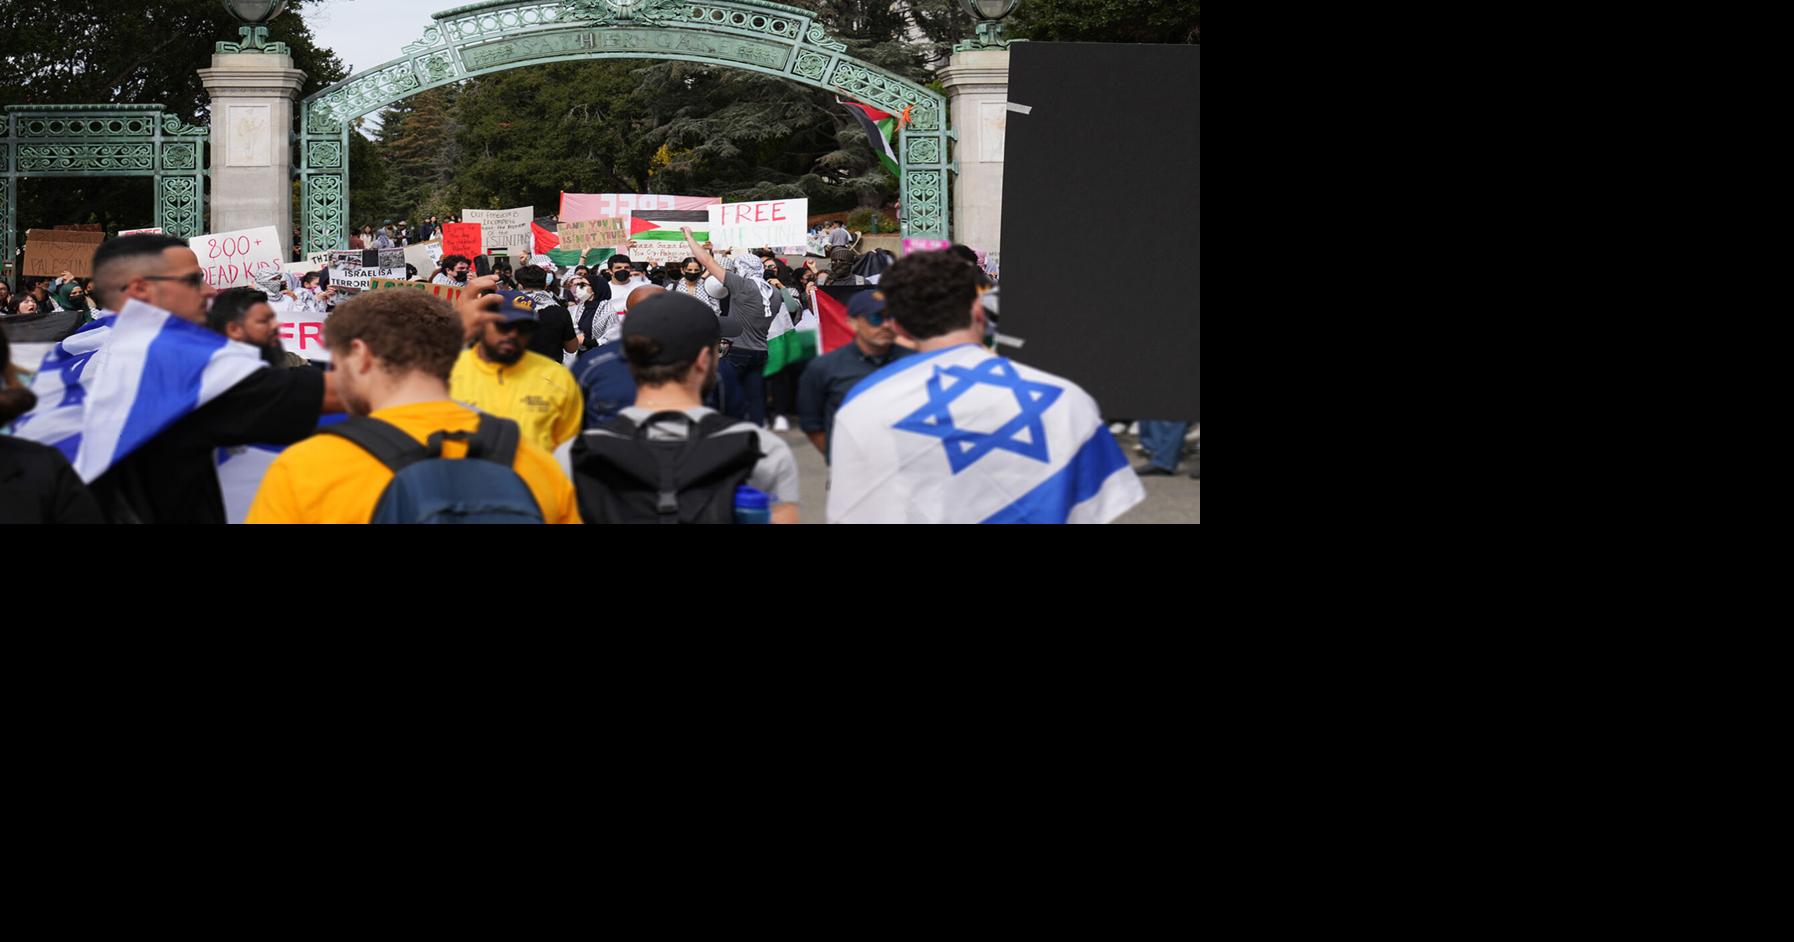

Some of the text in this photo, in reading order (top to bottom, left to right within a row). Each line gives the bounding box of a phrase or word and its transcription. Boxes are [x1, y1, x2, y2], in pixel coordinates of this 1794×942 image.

[721, 201, 786, 225] FREE
[30, 259, 89, 275] PALESTIN
[311, 254, 328, 265] THI
[344, 267, 393, 278] ISRAEL IS A
[331, 278, 370, 288] TERRORI
[511, 295, 533, 312] Cal
[276, 322, 327, 350] FR
